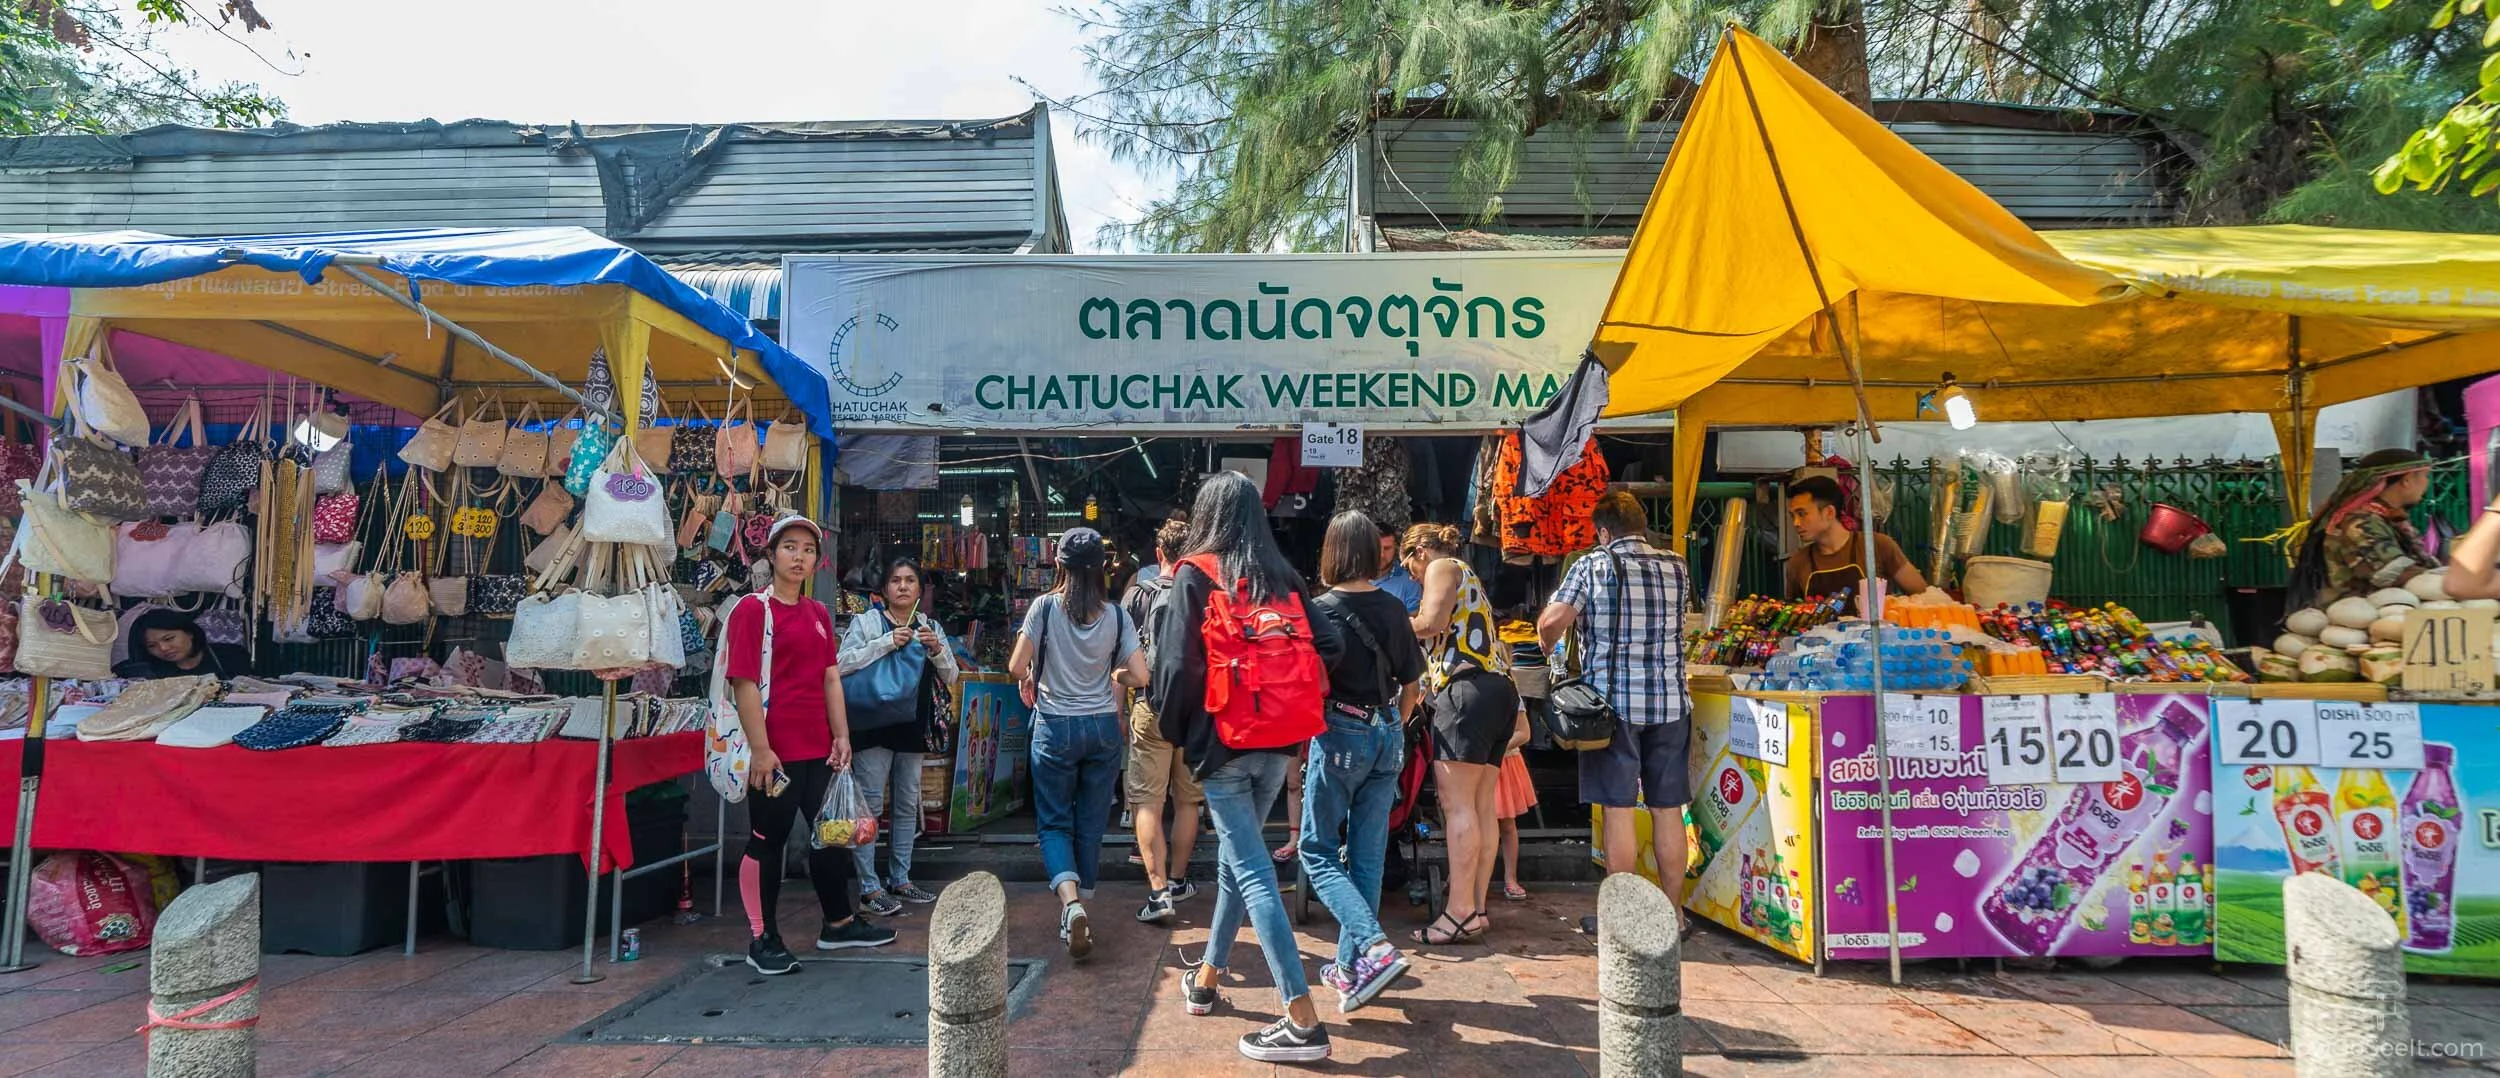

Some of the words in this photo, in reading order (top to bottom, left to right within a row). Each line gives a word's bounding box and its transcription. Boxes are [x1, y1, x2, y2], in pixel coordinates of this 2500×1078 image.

[313, 279, 376, 297] Stree
[400, 279, 444, 297] Fod
[1079, 276, 1546, 358] ตลาดนัดจตุจักร
[975, 373, 1245, 410] CHATUCHAK
[1261, 373, 1477, 408] WEEKEND
[1493, 373, 1573, 408] MA
[830, 401, 908, 413] HATUCHAK
[1308, 434, 1334, 444] Gate
[1336, 428, 1358, 445] 18
[408, 520, 432, 534] 120
[2364, 709, 2393, 722] 500
[1991, 727, 2045, 766] 15
[2057, 728, 2114, 768] 20
[2237, 719, 2298, 759] 20
[2349, 731, 2394, 759] 25
[1833, 791, 1868, 808] โออิชิ
